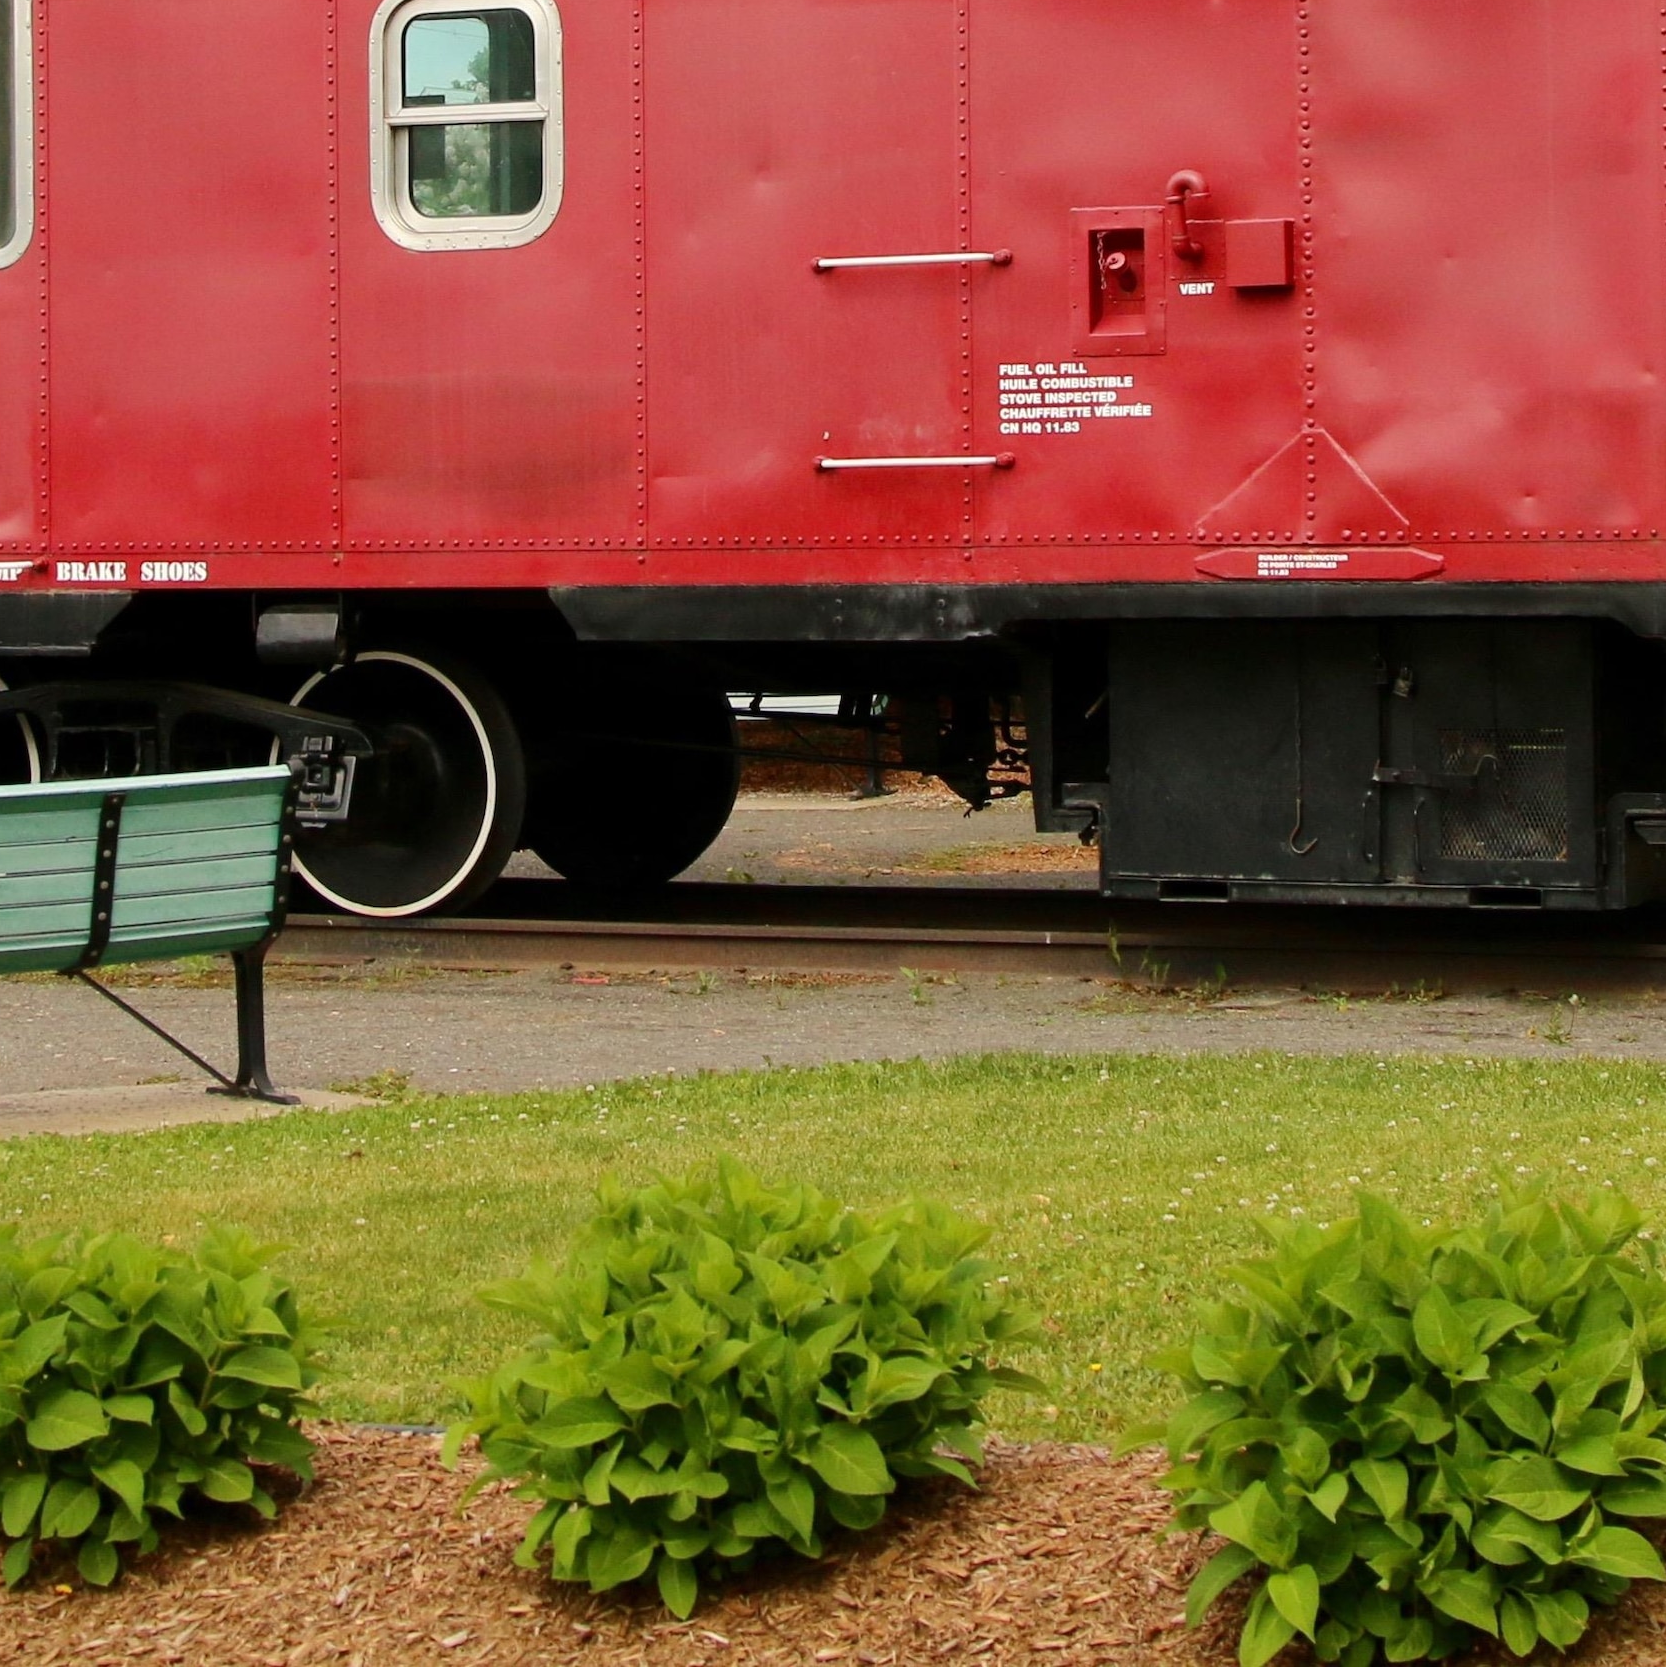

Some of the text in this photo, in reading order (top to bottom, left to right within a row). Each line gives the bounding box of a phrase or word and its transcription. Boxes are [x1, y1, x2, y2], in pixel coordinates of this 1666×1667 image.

[1179, 282, 1215, 295] VENT
[999, 362, 1088, 376] FUEL OIL FILL
[999, 376, 1133, 390] HUILE COMBUSTIBLE
[999, 390, 1118, 405] STOVE INSPECTED
[1000, 403, 1152, 419] CHAUFFRETTE VÉRIFIÉE
[1000, 420, 1081, 434] CN HQ 11.83
[56, 561, 126, 581] BRAKE
[140, 562, 207, 581] SHOES
